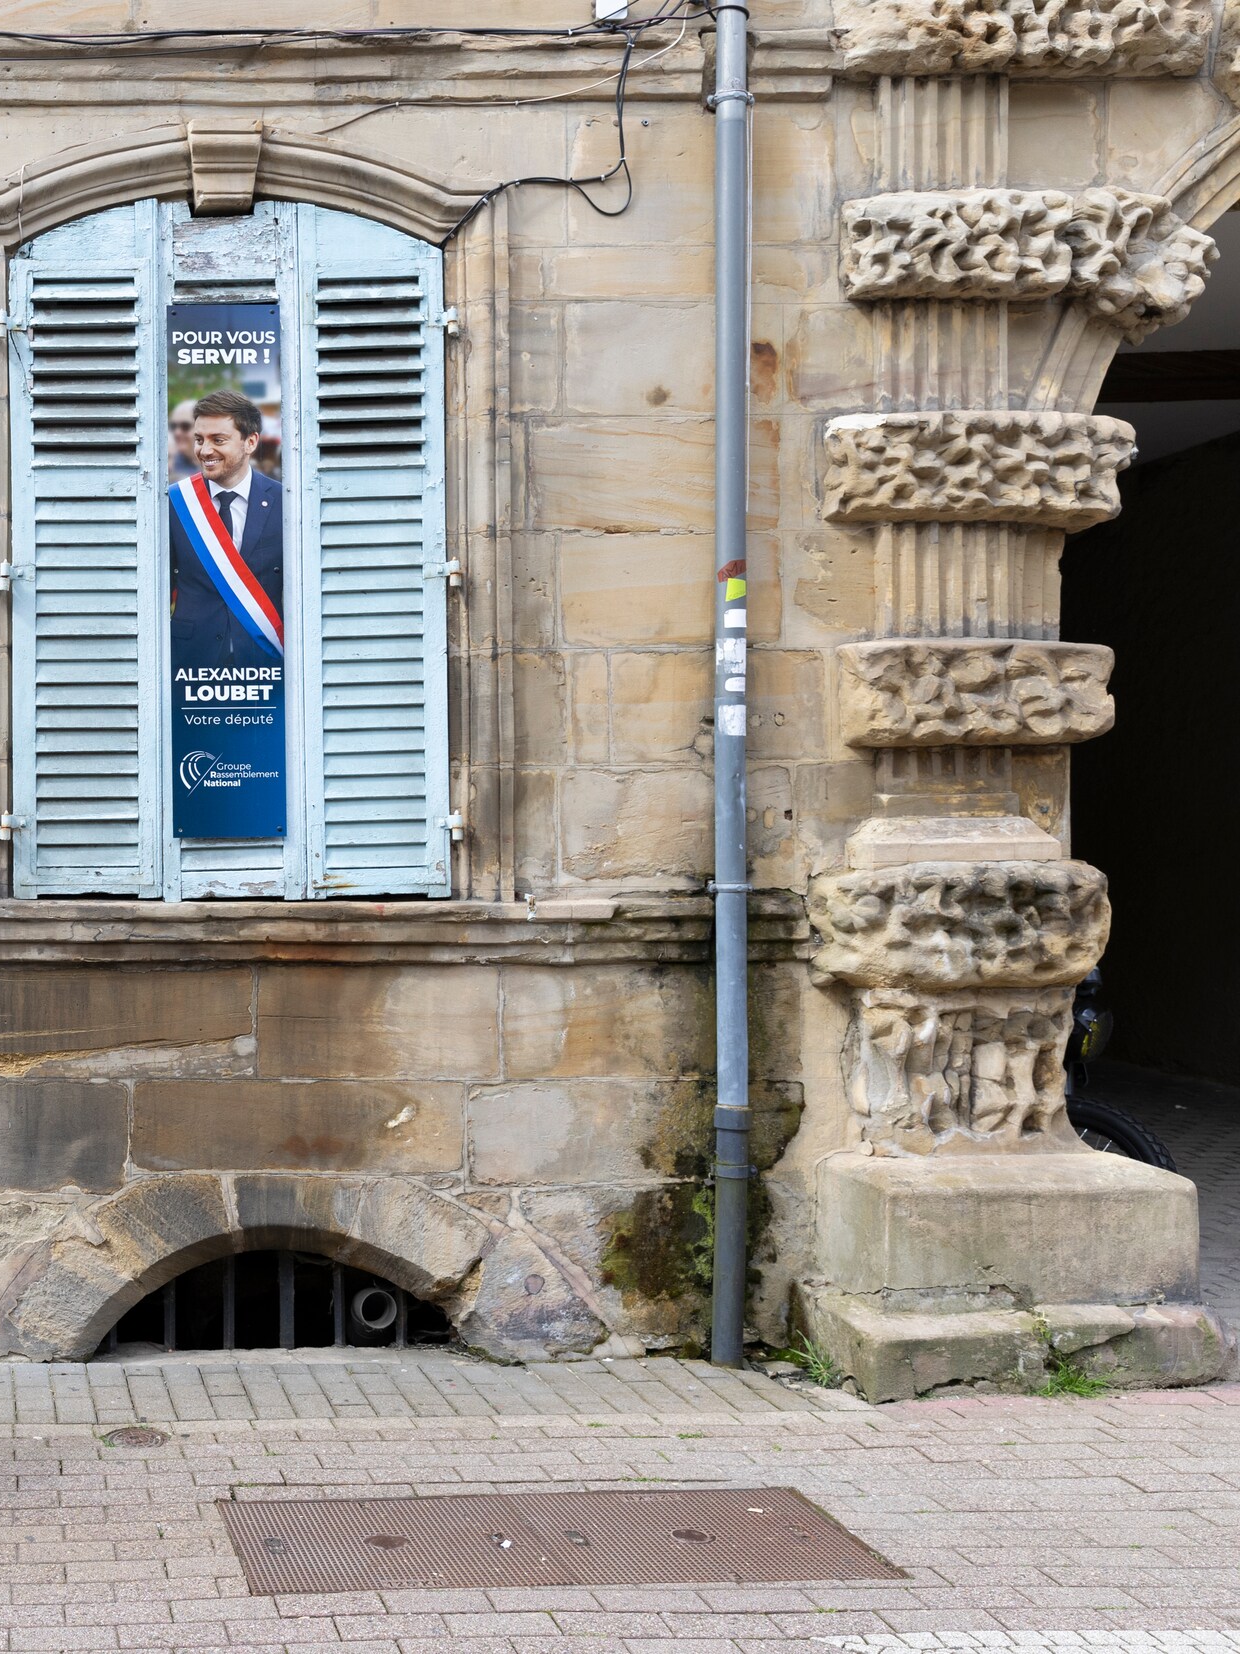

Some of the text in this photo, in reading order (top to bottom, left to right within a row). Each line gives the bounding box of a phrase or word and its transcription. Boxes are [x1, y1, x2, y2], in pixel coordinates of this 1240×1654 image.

[172, 331, 276, 344] POUR VOUS
[177, 348, 271, 364] SERVIR !
[175, 667, 282, 681] ALEXANDRE
[185, 685, 273, 701] LOUBET
[184, 714, 274, 727] Votre député
[216, 762, 252, 771] Groupe
[203, 779, 241, 787] National
